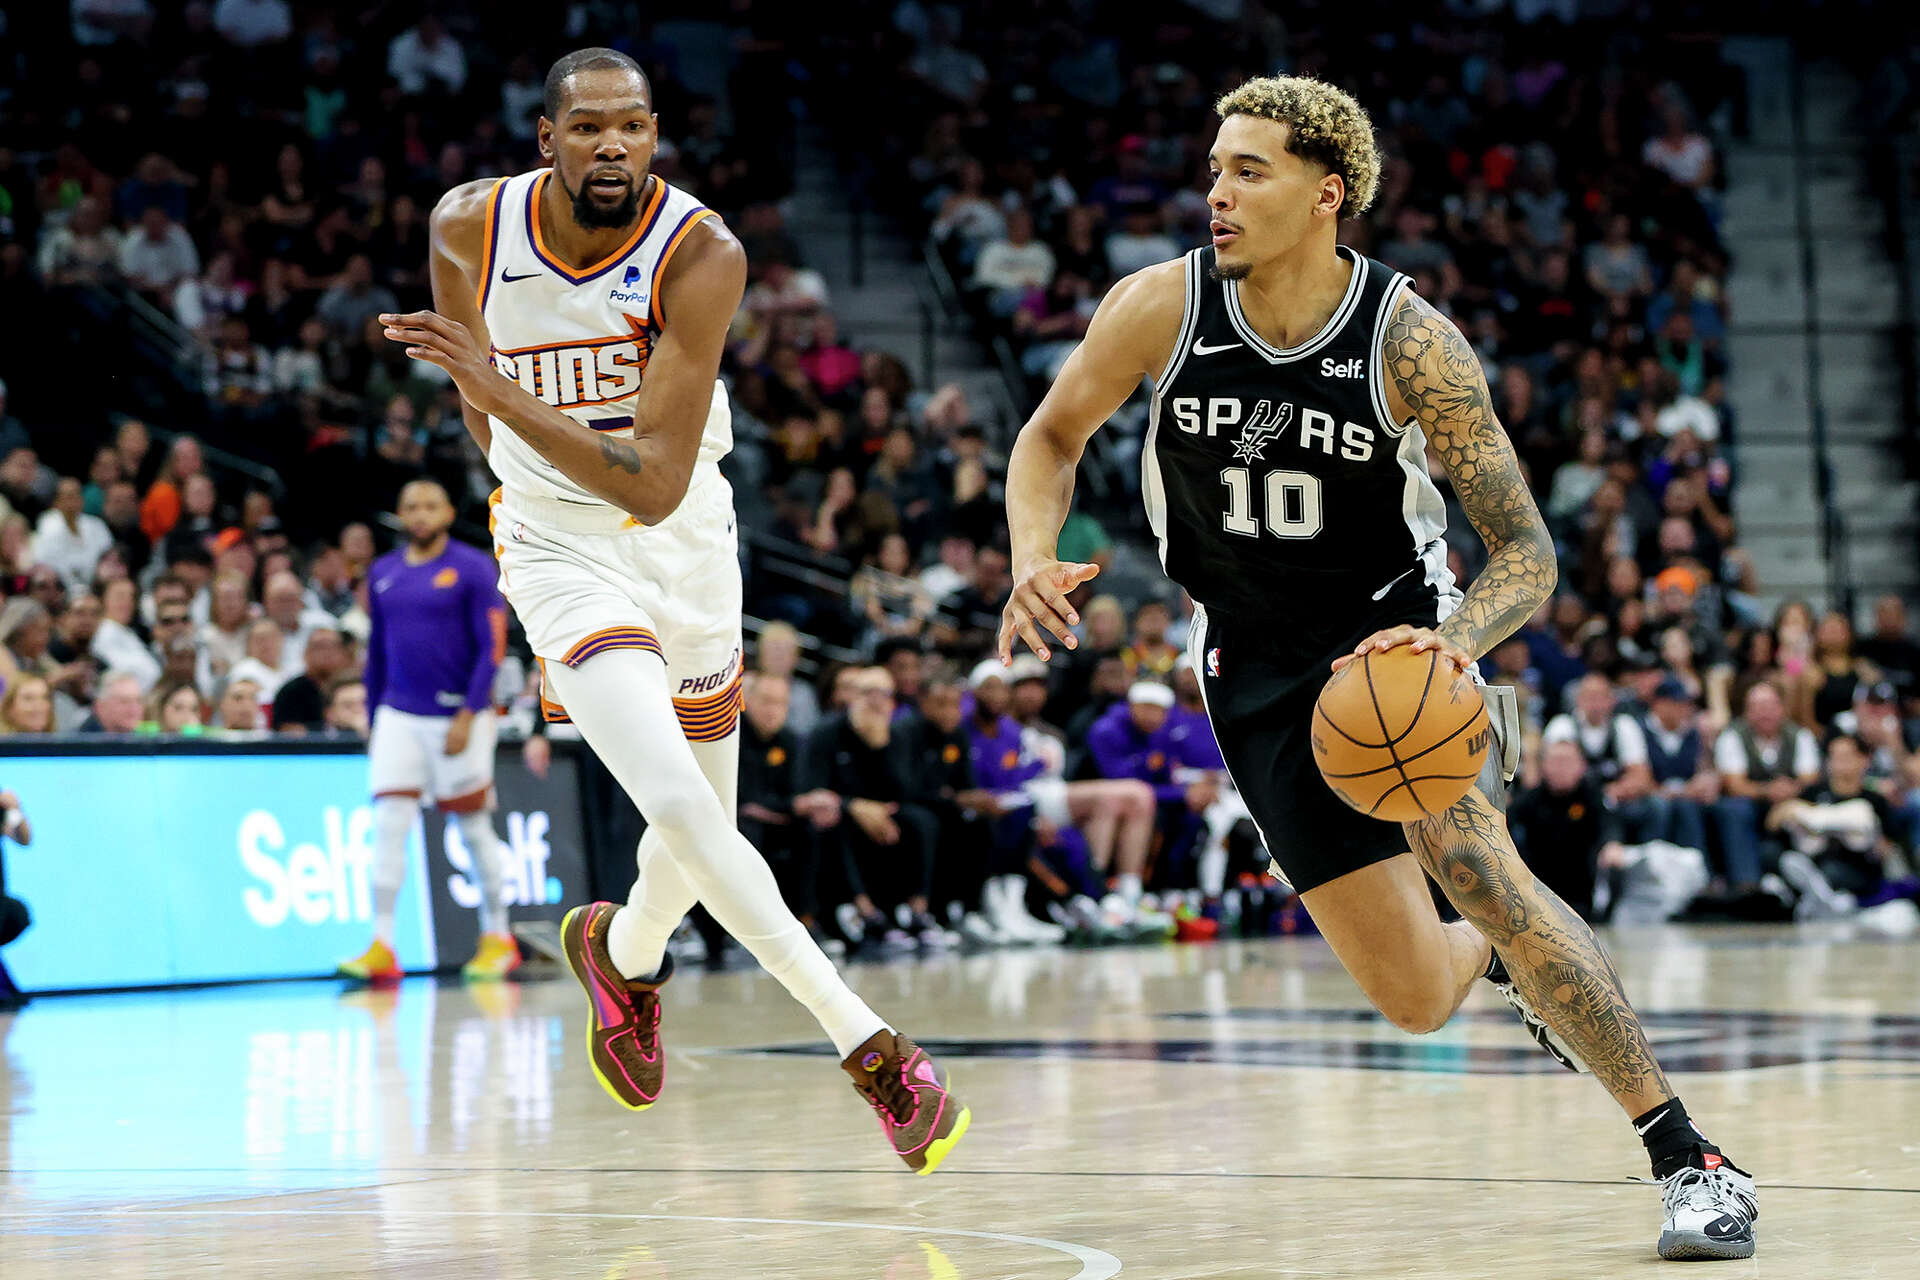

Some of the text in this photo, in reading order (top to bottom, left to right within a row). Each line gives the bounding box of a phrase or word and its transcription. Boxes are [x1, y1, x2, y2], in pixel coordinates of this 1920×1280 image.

[609, 289, 649, 304] PayPal
[1320, 357, 1366, 380] Self.
[1171, 396, 1376, 465] SPURS
[1219, 466, 1324, 541] 10
